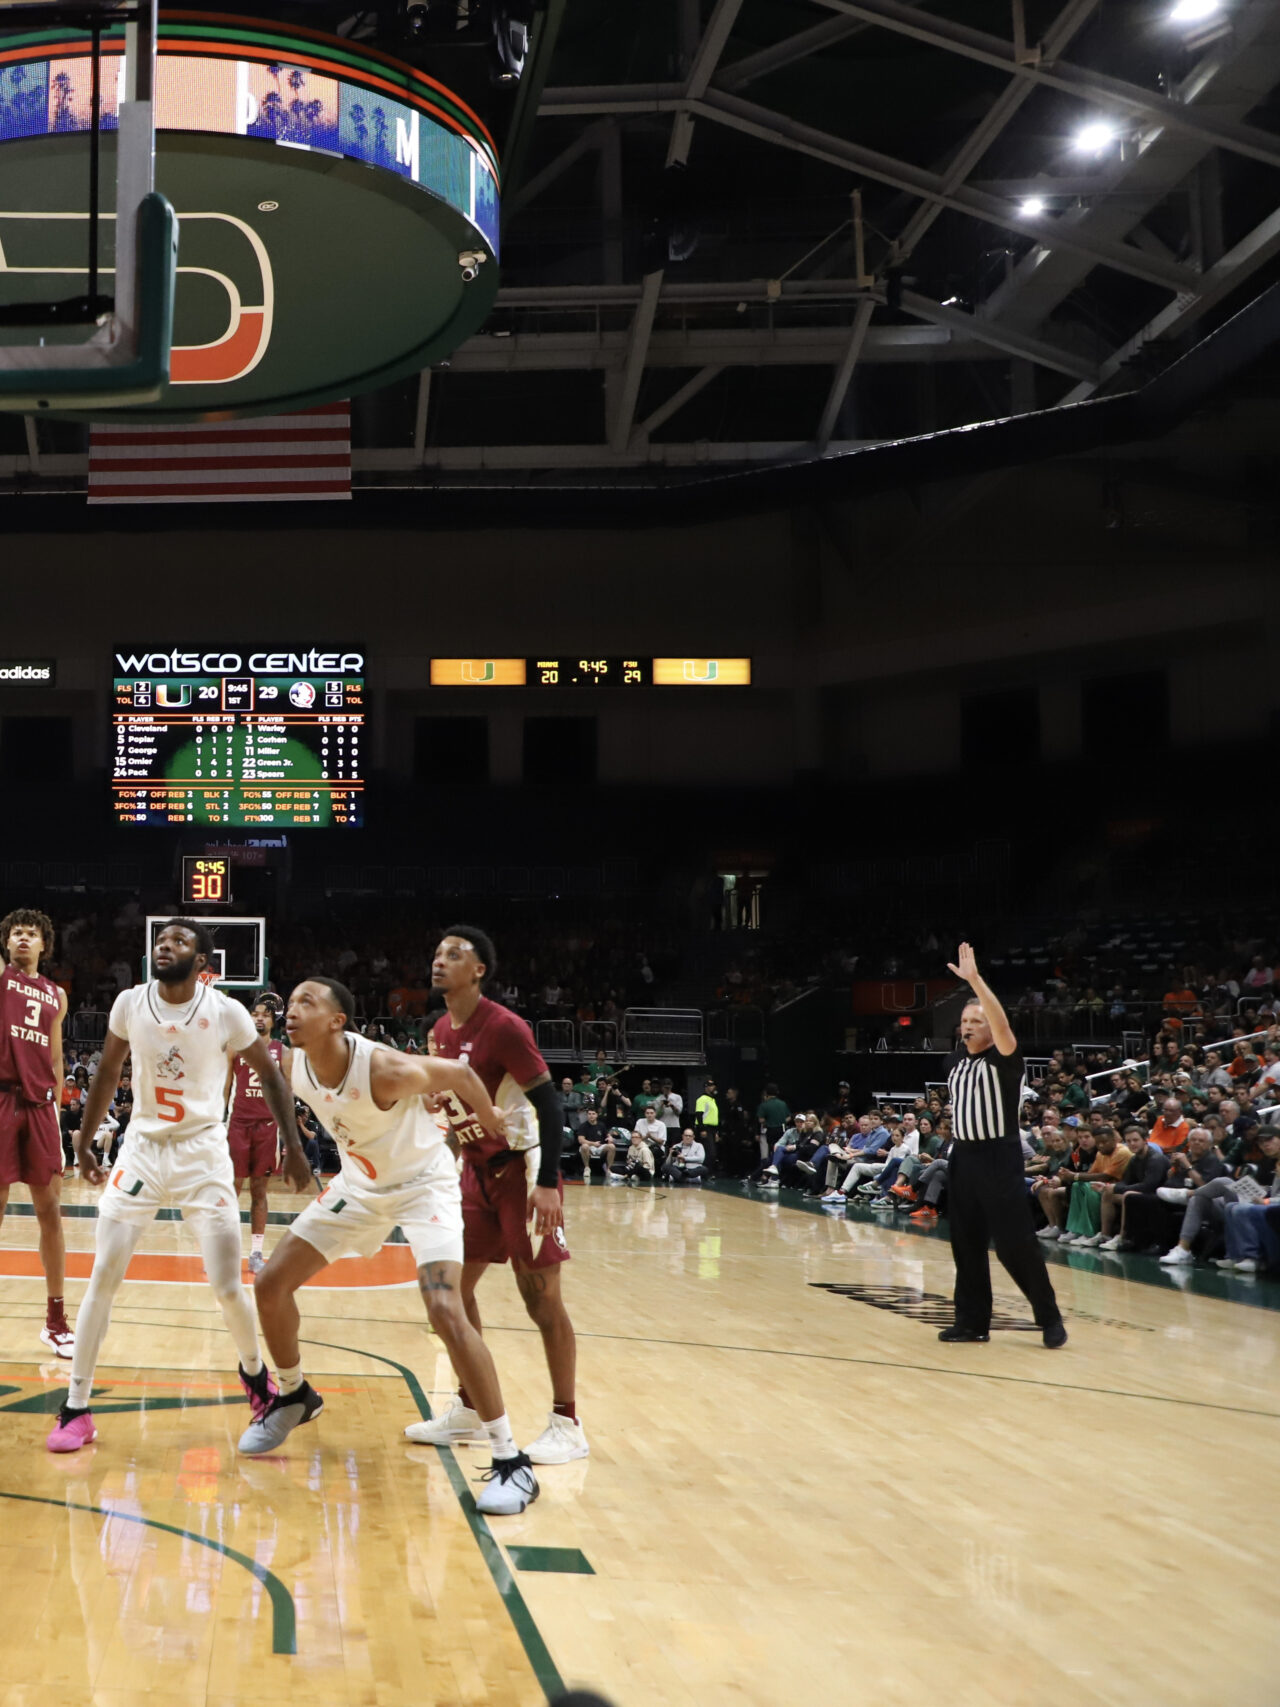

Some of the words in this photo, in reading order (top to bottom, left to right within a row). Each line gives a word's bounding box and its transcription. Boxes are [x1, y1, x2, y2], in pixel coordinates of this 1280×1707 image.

[578, 660, 608, 673] 9:45
[541, 671, 559, 684] 20
[624, 671, 642, 684] 29
[199, 687, 218, 698] 20
[227, 684, 248, 693] 9:45
[259, 687, 278, 698] 29
[117, 725, 125, 734] 0
[247, 724, 252, 733] 1
[118, 735, 124, 743] 5
[246, 736, 253, 744] 3
[117, 746, 124, 755] 7
[245, 747, 254, 755] 11
[115, 757, 126, 766] 15
[243, 758, 256, 767] 22
[114, 768, 127, 776] 24
[243, 769, 256, 778] 23
[195, 860, 226, 875] 9:45
[192, 874, 222, 899] 30
[7, 979, 59, 1011] FLORIDA
[24, 1000, 42, 1027] 3
[10, 1024, 49, 1047] STATE
[245, 1089, 263, 1098] STA
[154, 1086, 185, 1123] 5
[456, 1123, 485, 1145] ATE
